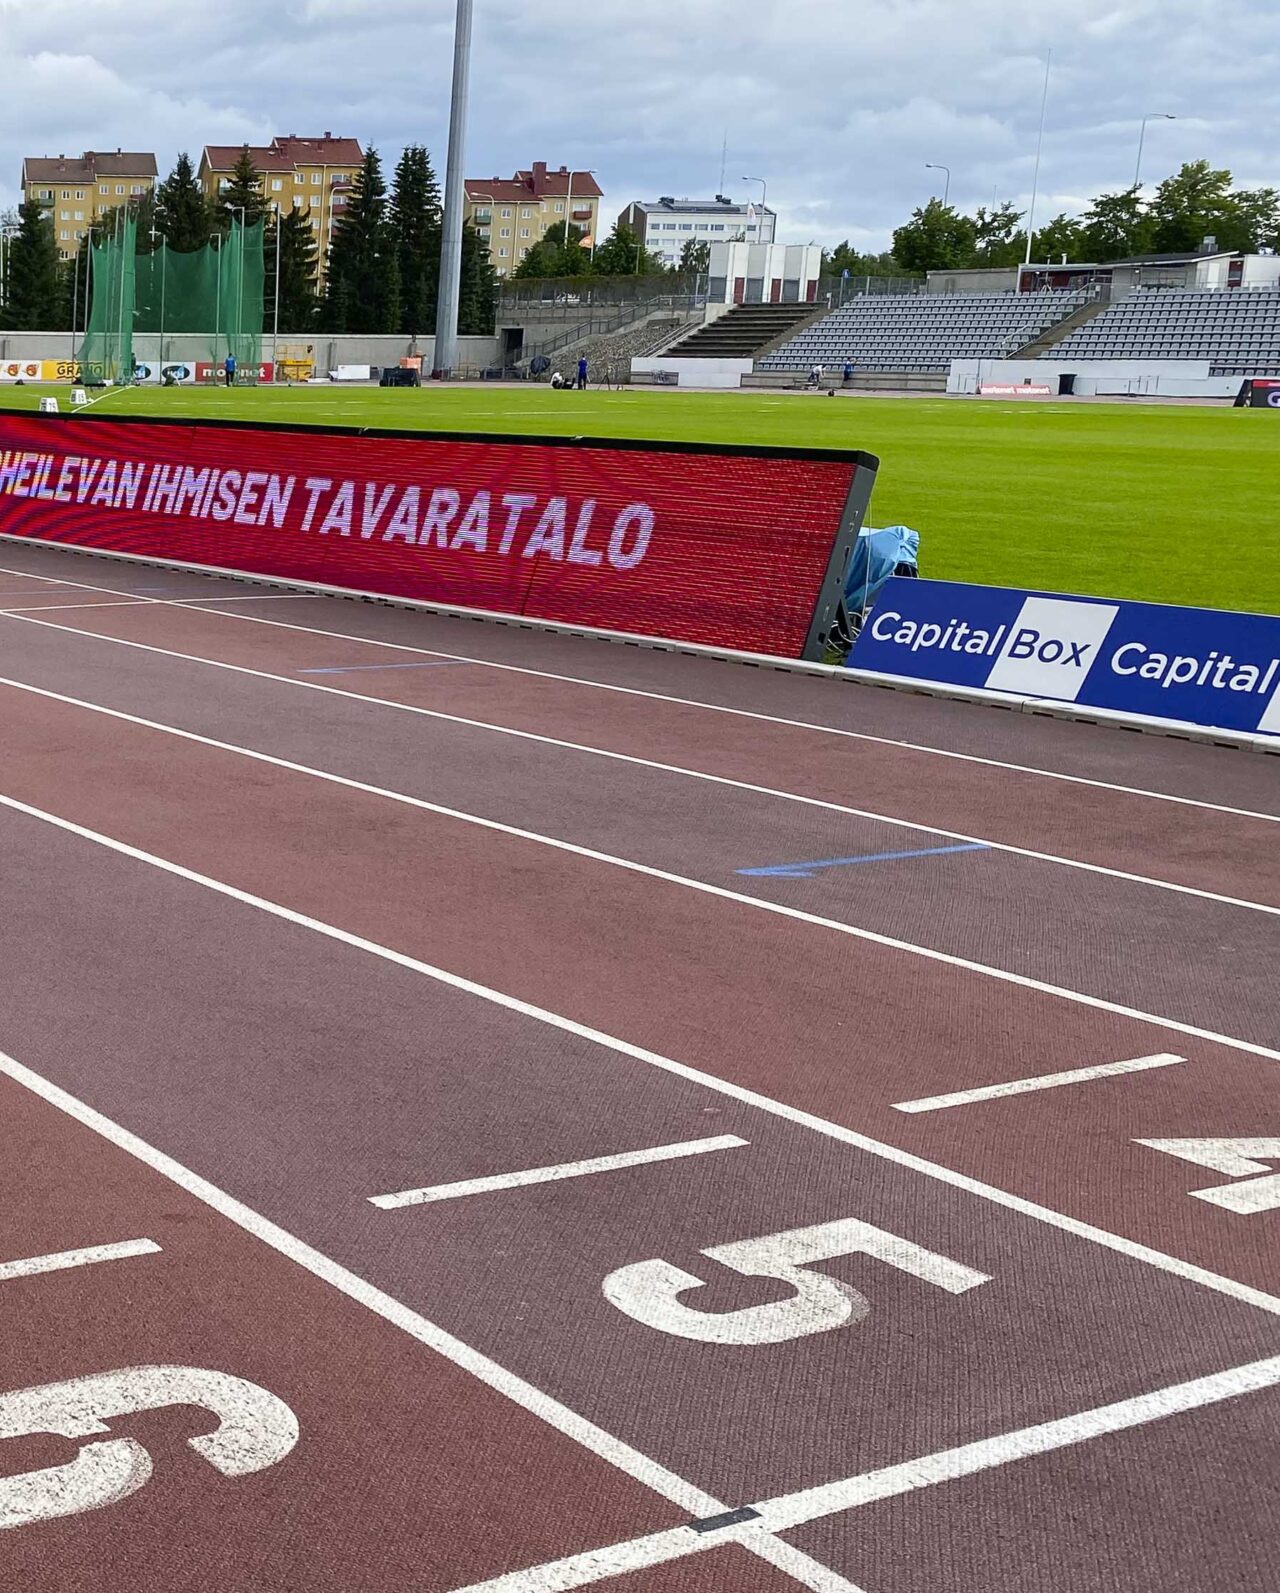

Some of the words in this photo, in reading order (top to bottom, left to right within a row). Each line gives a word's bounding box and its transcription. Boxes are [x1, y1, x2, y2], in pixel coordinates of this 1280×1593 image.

[141, 463, 297, 528] IHMISEN
[300, 476, 656, 570] TAVARATALO
[602, 1217, 994, 1347] 5
